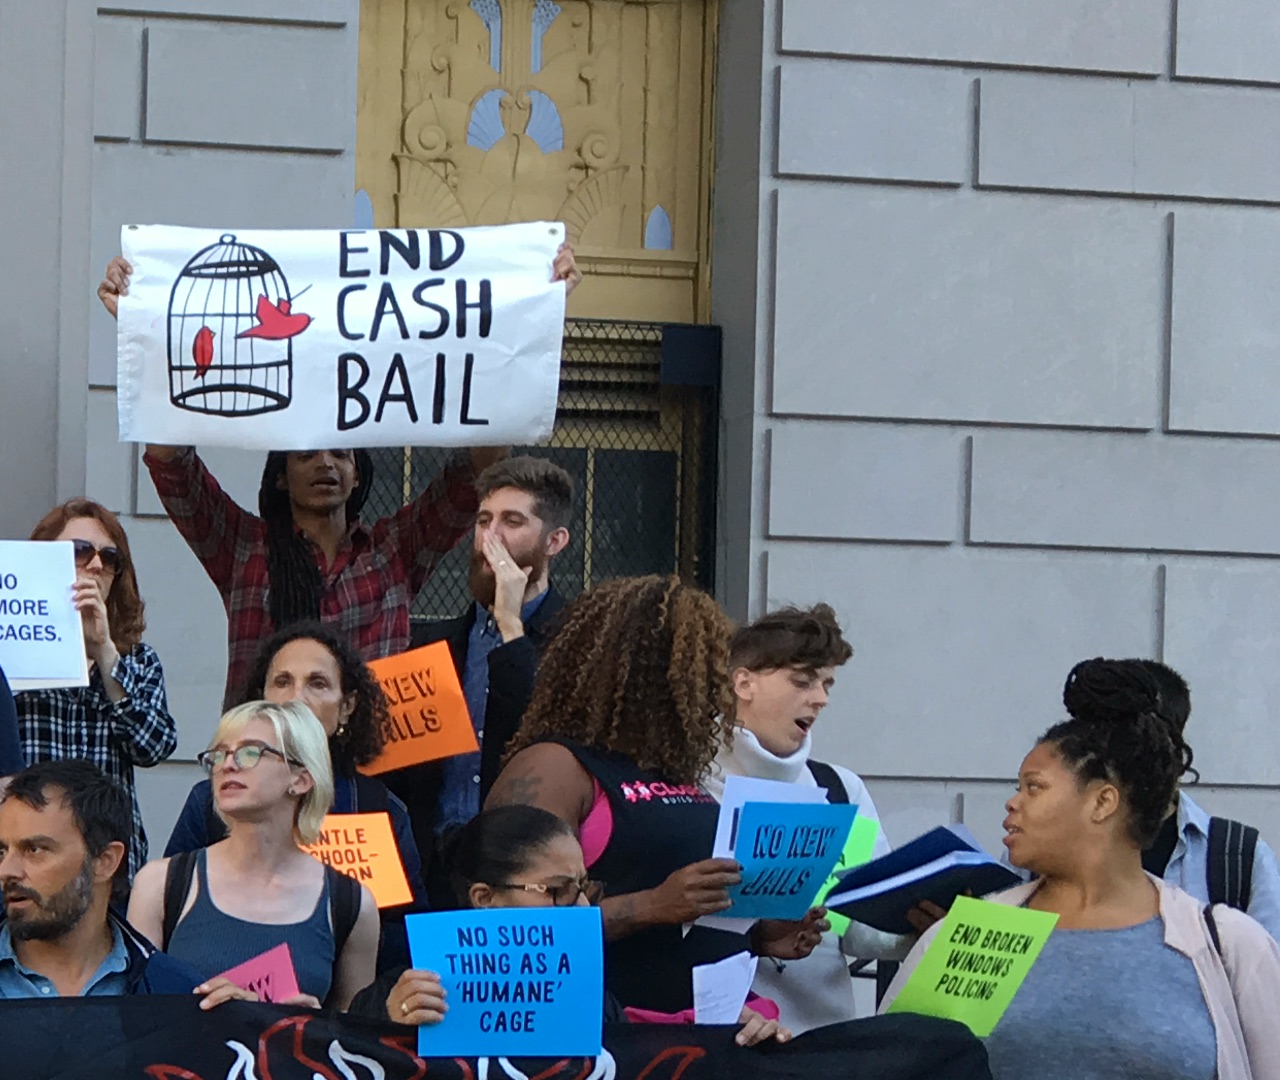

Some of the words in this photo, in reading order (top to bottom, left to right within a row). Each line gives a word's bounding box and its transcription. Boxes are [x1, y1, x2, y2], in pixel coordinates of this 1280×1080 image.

[339, 230, 465, 278] END
[337, 278, 492, 342] CASH
[336, 352, 490, 431] BAIL
[380, 704, 442, 744] AILS
[319, 828, 367, 846] NTLE
[752, 824, 786, 859] NO
[786, 825, 837, 859] NEW
[740, 866, 814, 897] JAILS
[457, 926, 488, 947] NO
[498, 925, 554, 947] SUCH
[949, 923, 982, 947] END
[980, 929, 1034, 955] BROKEN
[445, 953, 510, 975] THING
[520, 953, 547, 974] AS
[558, 952, 571, 975] A
[946, 948, 1014, 978] WINDOWS
[934, 973, 998, 1001] POLICING
[480, 1010, 536, 1033] CAGE
